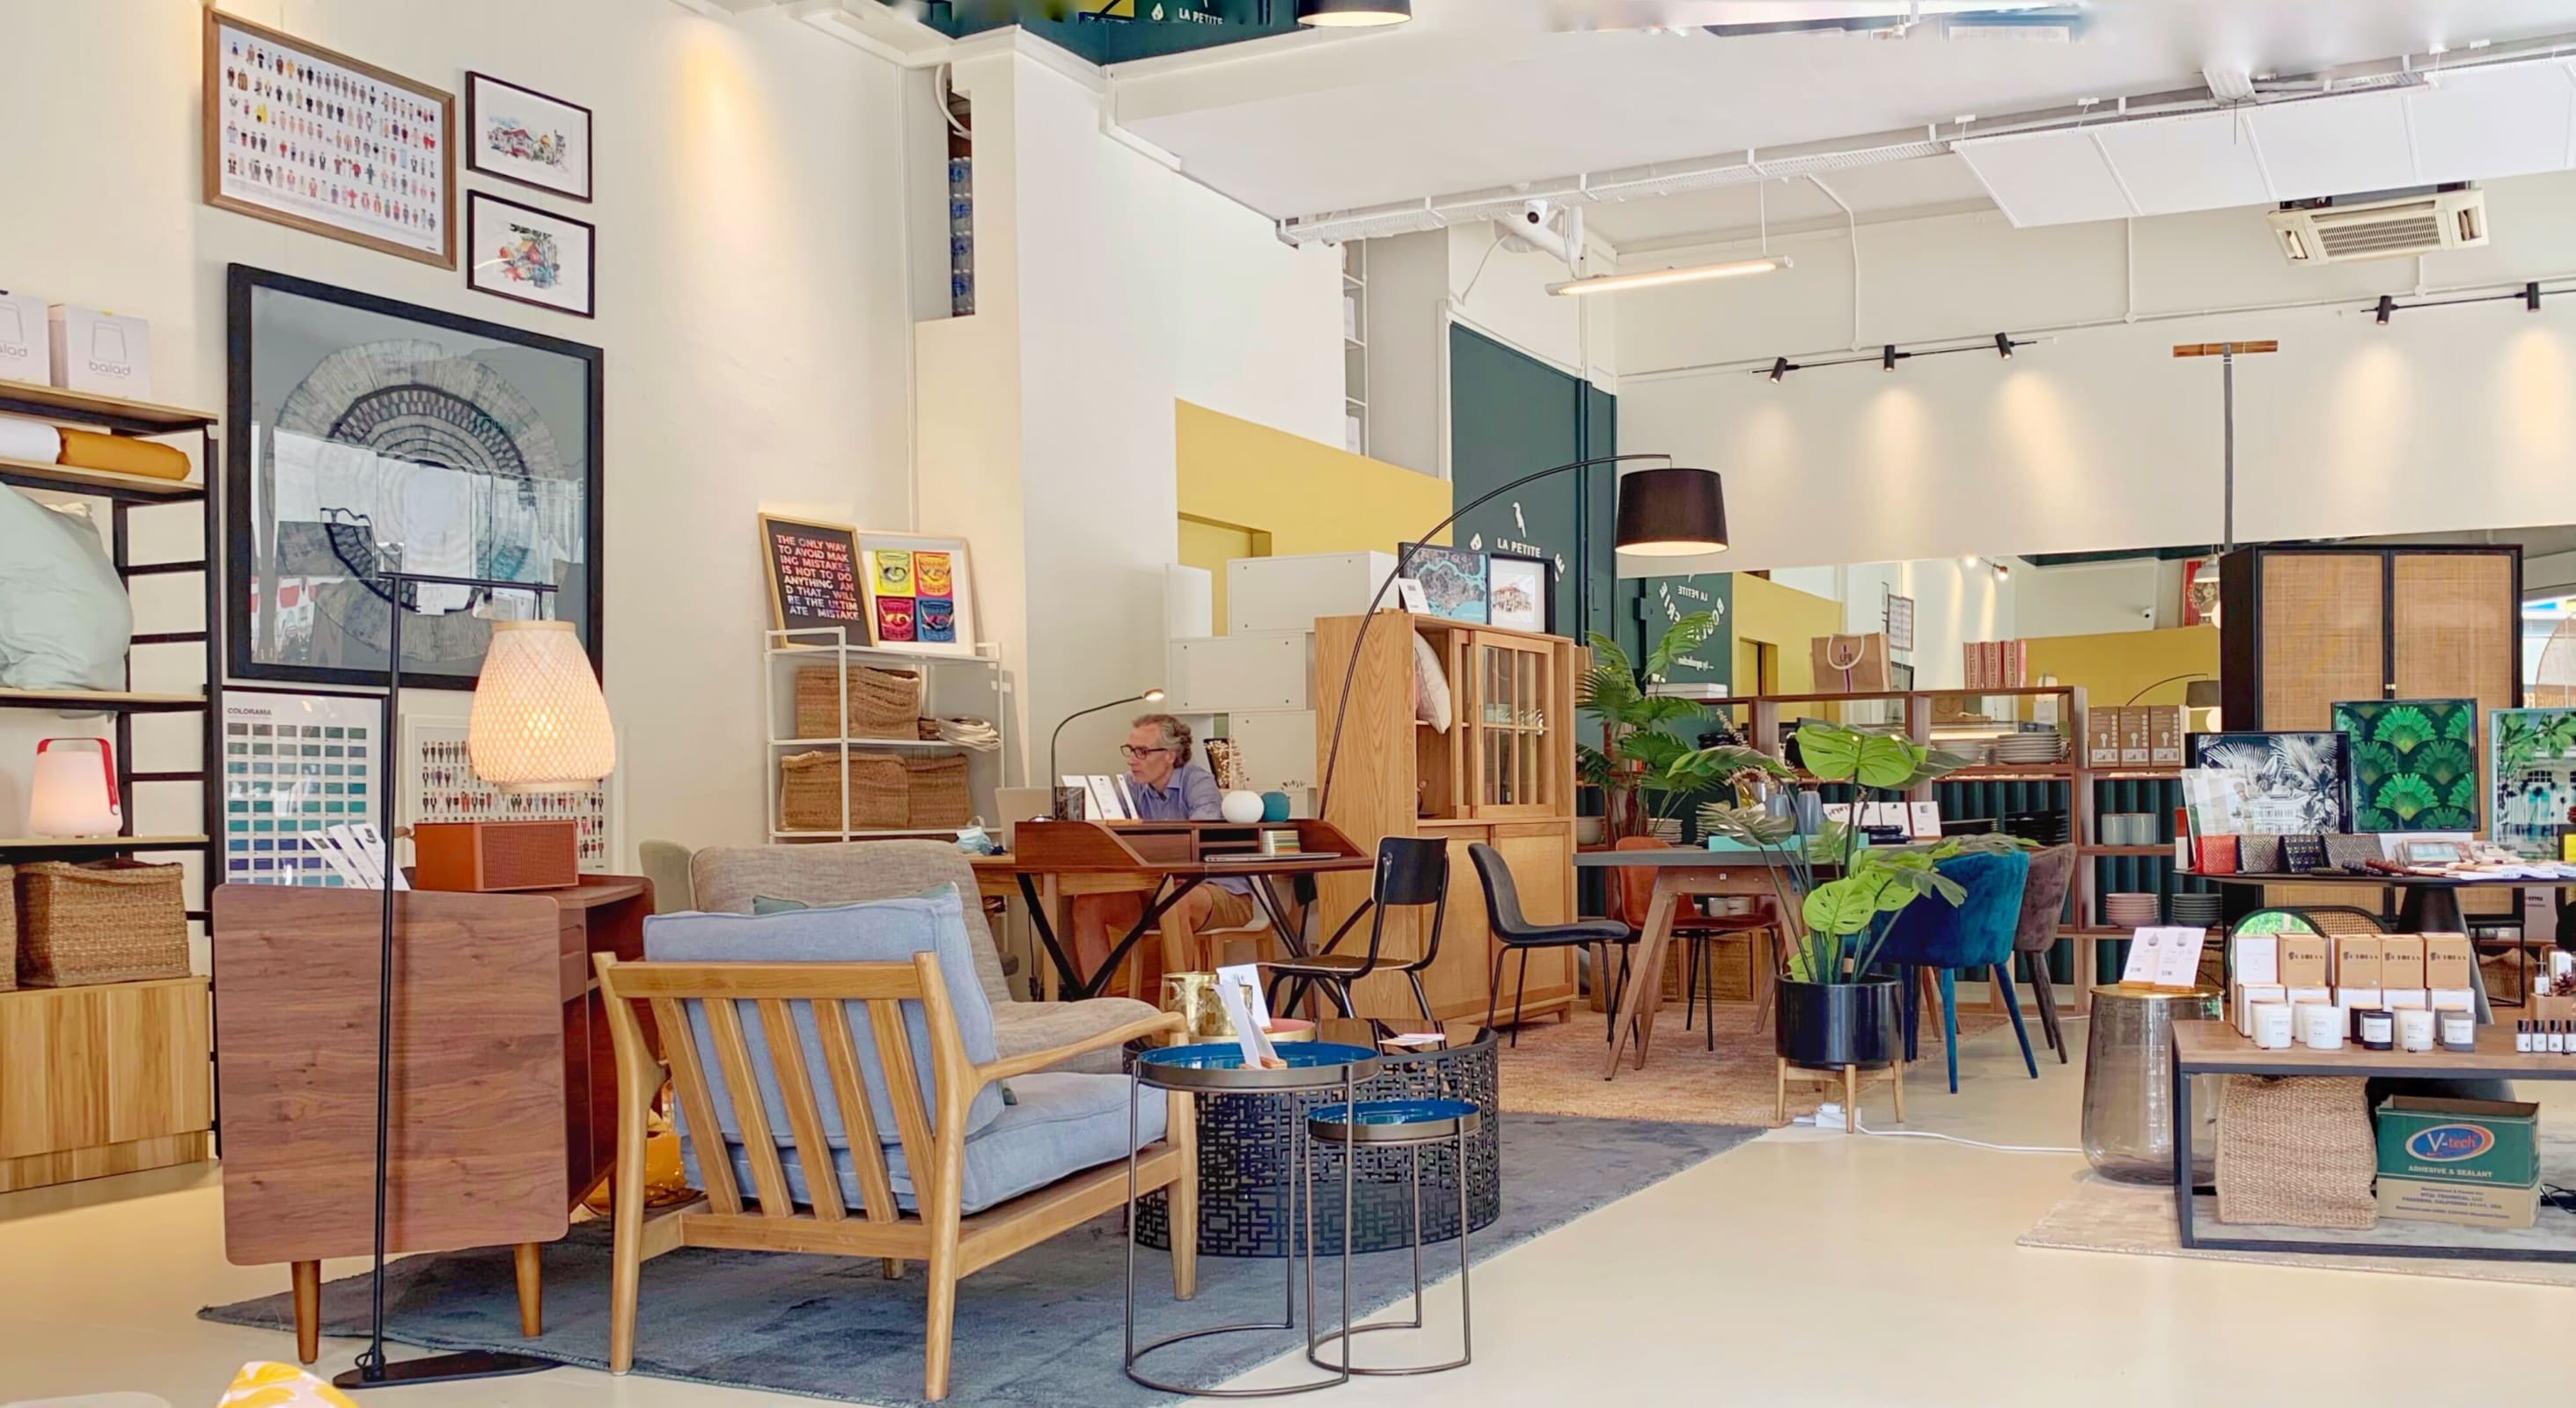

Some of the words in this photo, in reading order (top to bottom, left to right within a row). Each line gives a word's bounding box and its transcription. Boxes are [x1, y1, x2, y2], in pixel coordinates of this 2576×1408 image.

[1178, 7, 1191, 20] LA
[1193, 11, 1223, 26] PETITE
[0, 343, 28, 357] lad
[89, 360, 131, 377] balad
[776, 534, 796, 546] THE
[798, 538, 824, 549] ONLY
[825, 541, 847, 553] WAY
[1497, 537, 1508, 551] LA
[1511, 541, 1541, 558] PETITE
[777, 545, 792, 554] TO
[795, 547, 825, 559] AVOID
[826, 552, 849, 562] MAK
[780, 554, 798, 565] ING
[802, 558, 851, 572] MISTAKES
[782, 564, 792, 575] IS
[795, 567, 817, 577] NOT
[819, 569, 833, 579] TO
[837, 572, 853, 582] DO
[783, 576, 833, 590] ANYTHING
[840, 582, 855, 592] AN
[785, 585, 794, 595] D
[832, 590, 856, 602] WILL
[787, 594, 801, 605] BE
[804, 597, 825, 607] THE
[828, 598, 859, 611] ULTIM
[789, 605, 809, 616] ATE
[817, 608, 860, 621] MISTAKE
[227, 707, 273, 715] COLORAMA
[2426, 1133, 2476, 1152] V-tech
[2408, 1165, 2446, 1175] ADHESIVE
[2456, 1168, 2492, 1178] SEALANT
